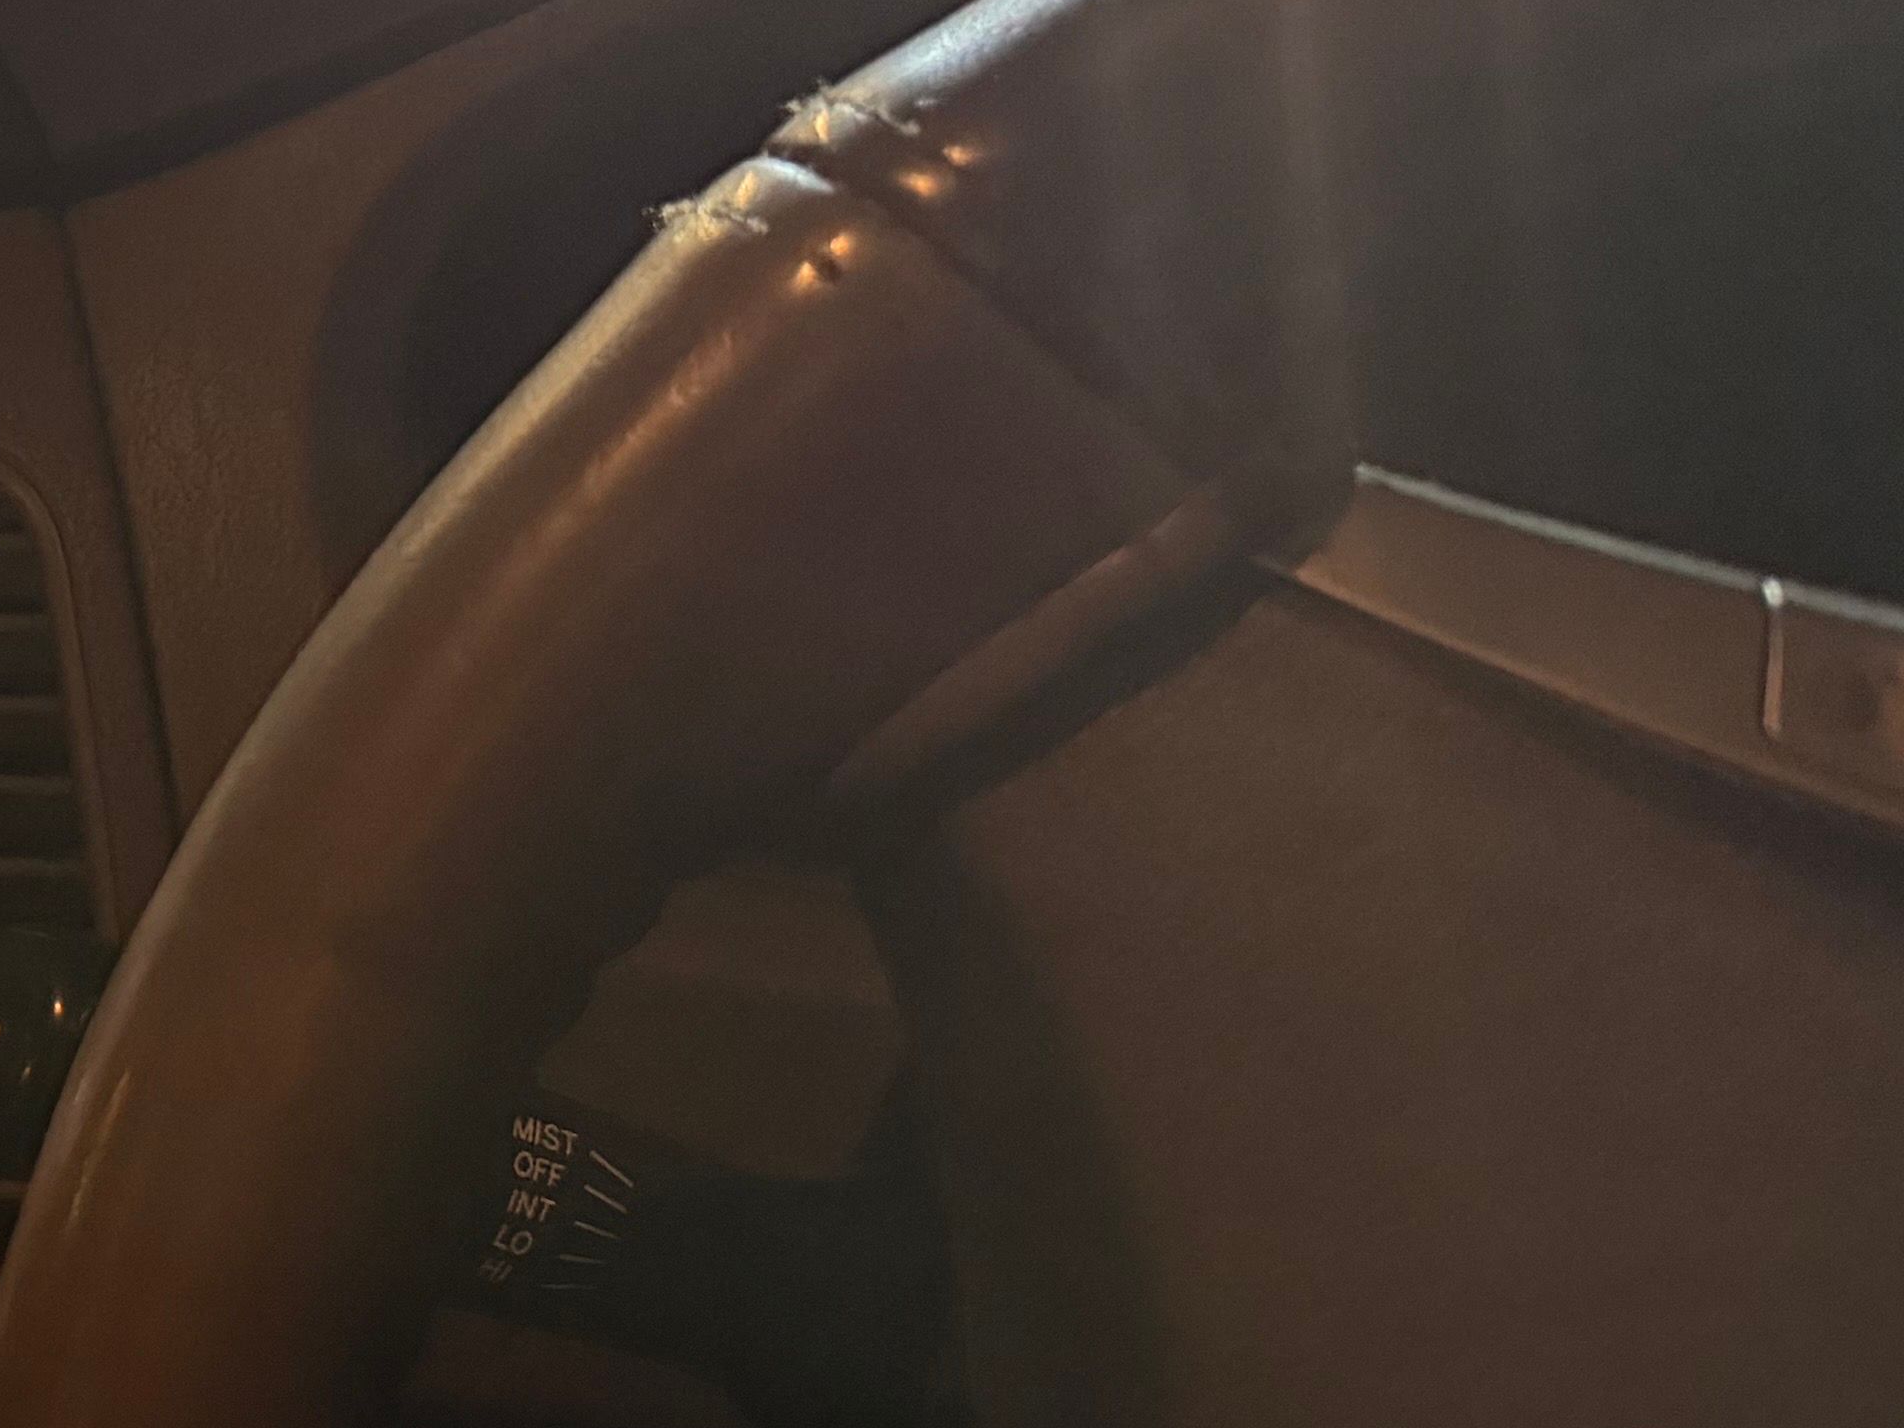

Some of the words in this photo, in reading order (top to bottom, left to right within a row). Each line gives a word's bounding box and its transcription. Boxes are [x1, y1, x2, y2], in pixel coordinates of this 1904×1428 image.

[512, 1115, 579, 1156] MIST
[513, 1150, 568, 1188] OFF
[505, 1188, 557, 1222] INT
[492, 1222, 534, 1256] LO
